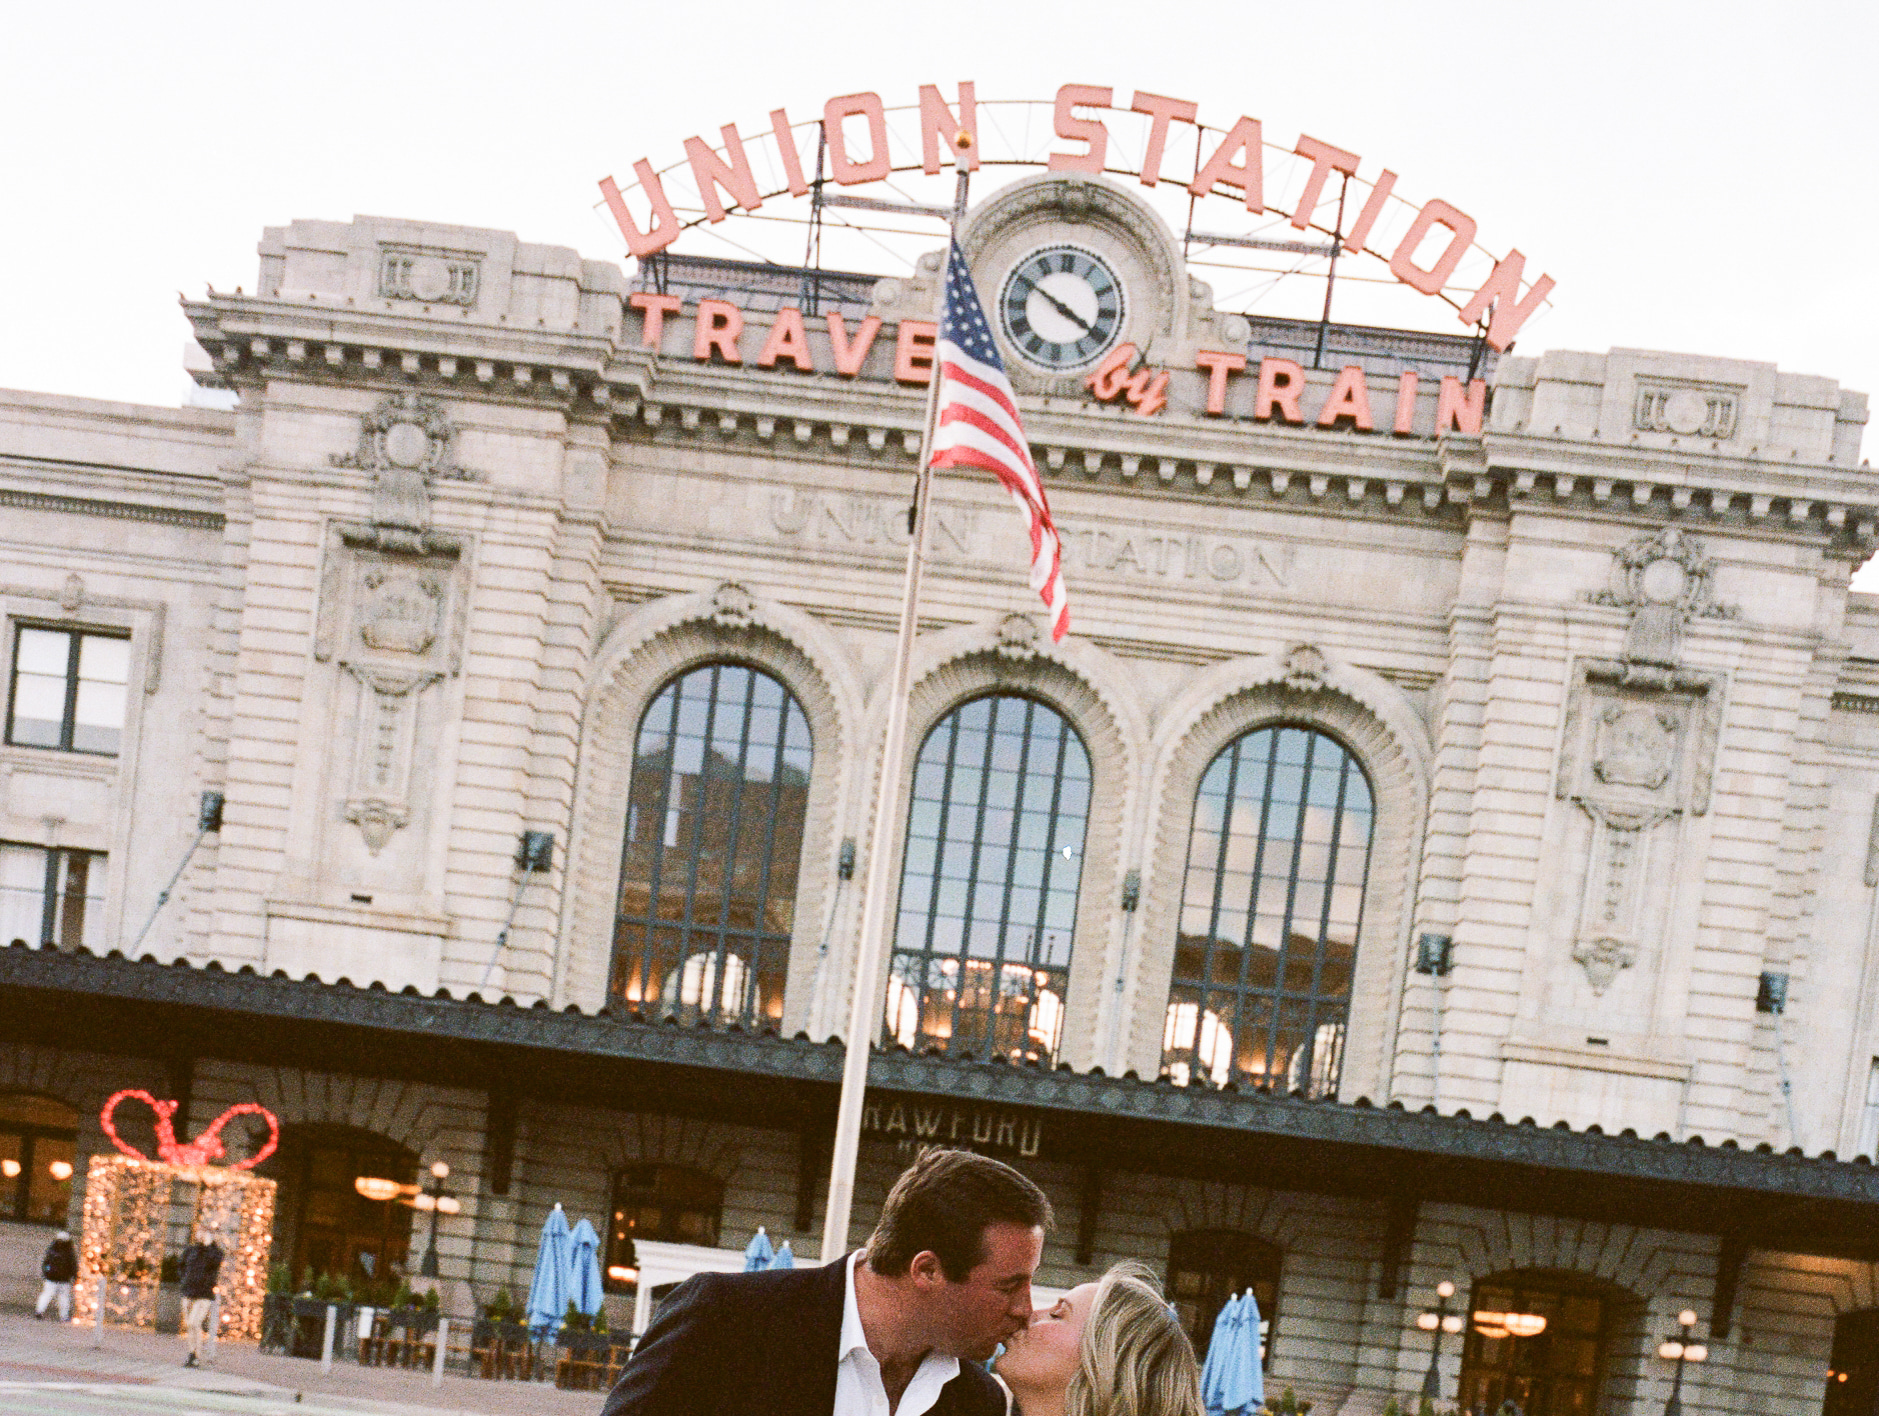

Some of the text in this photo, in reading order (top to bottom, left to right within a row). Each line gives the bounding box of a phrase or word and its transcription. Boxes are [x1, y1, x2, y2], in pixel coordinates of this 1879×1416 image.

[598, 81, 979, 258] UNION
[1048, 83, 1556, 352] STATION
[631, 293, 937, 384] TRAVE
[1085, 342, 1169, 416] by
[1197, 350, 1486, 436] TRAIN
[861, 1102, 1042, 1156] RAWFORD
